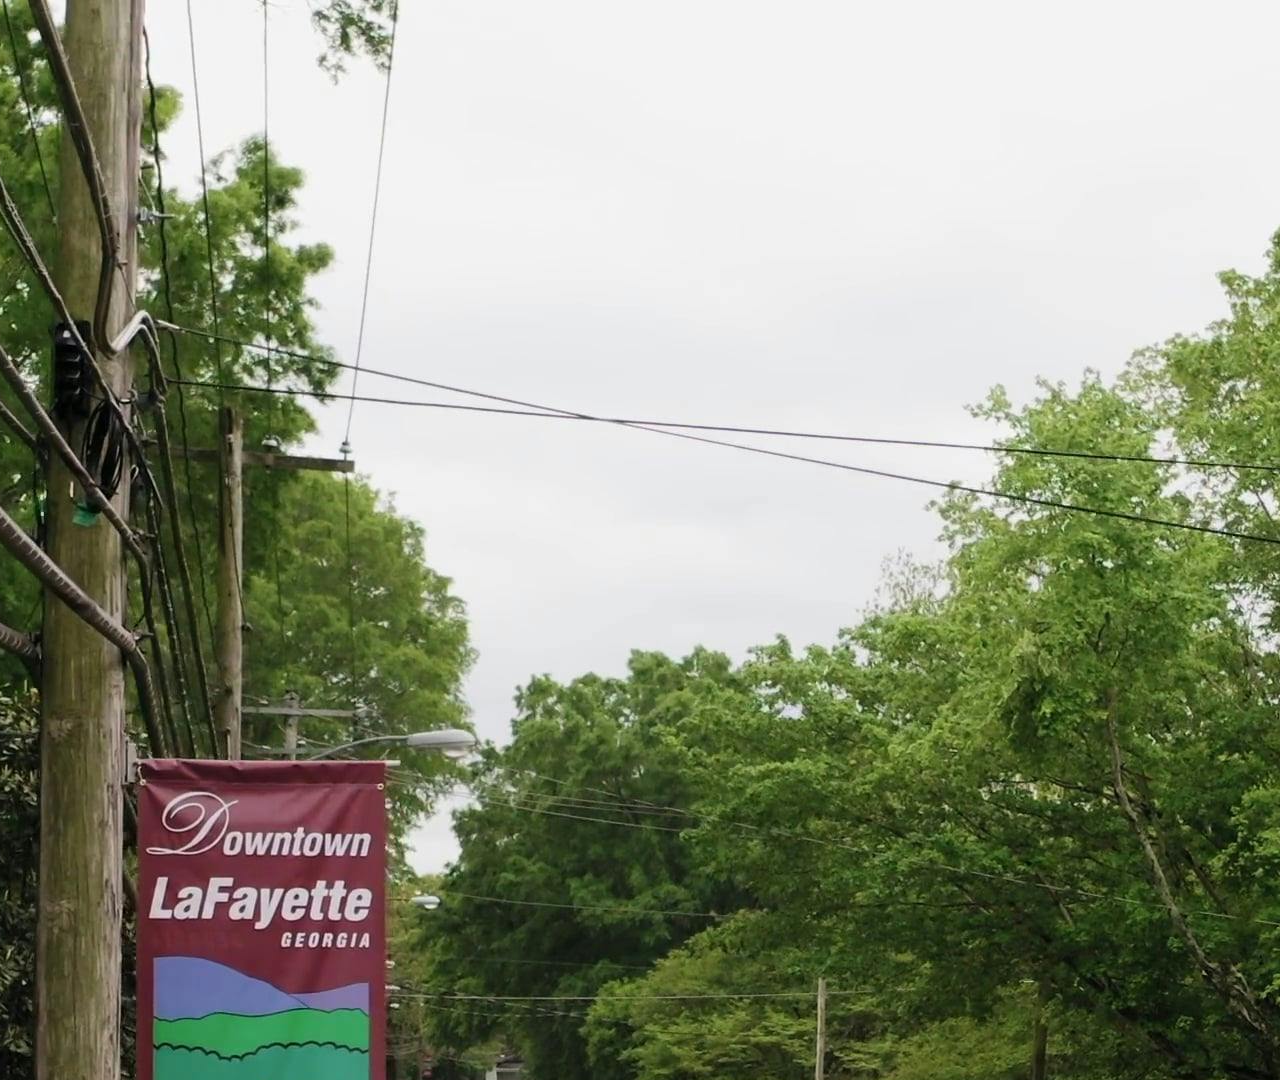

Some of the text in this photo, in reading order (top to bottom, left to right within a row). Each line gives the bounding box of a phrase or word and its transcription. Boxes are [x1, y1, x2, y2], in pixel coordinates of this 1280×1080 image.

[146, 791, 371, 857] Downtown
[148, 876, 373, 930] LaFayette
[280, 932, 371, 949] GEORGIA
